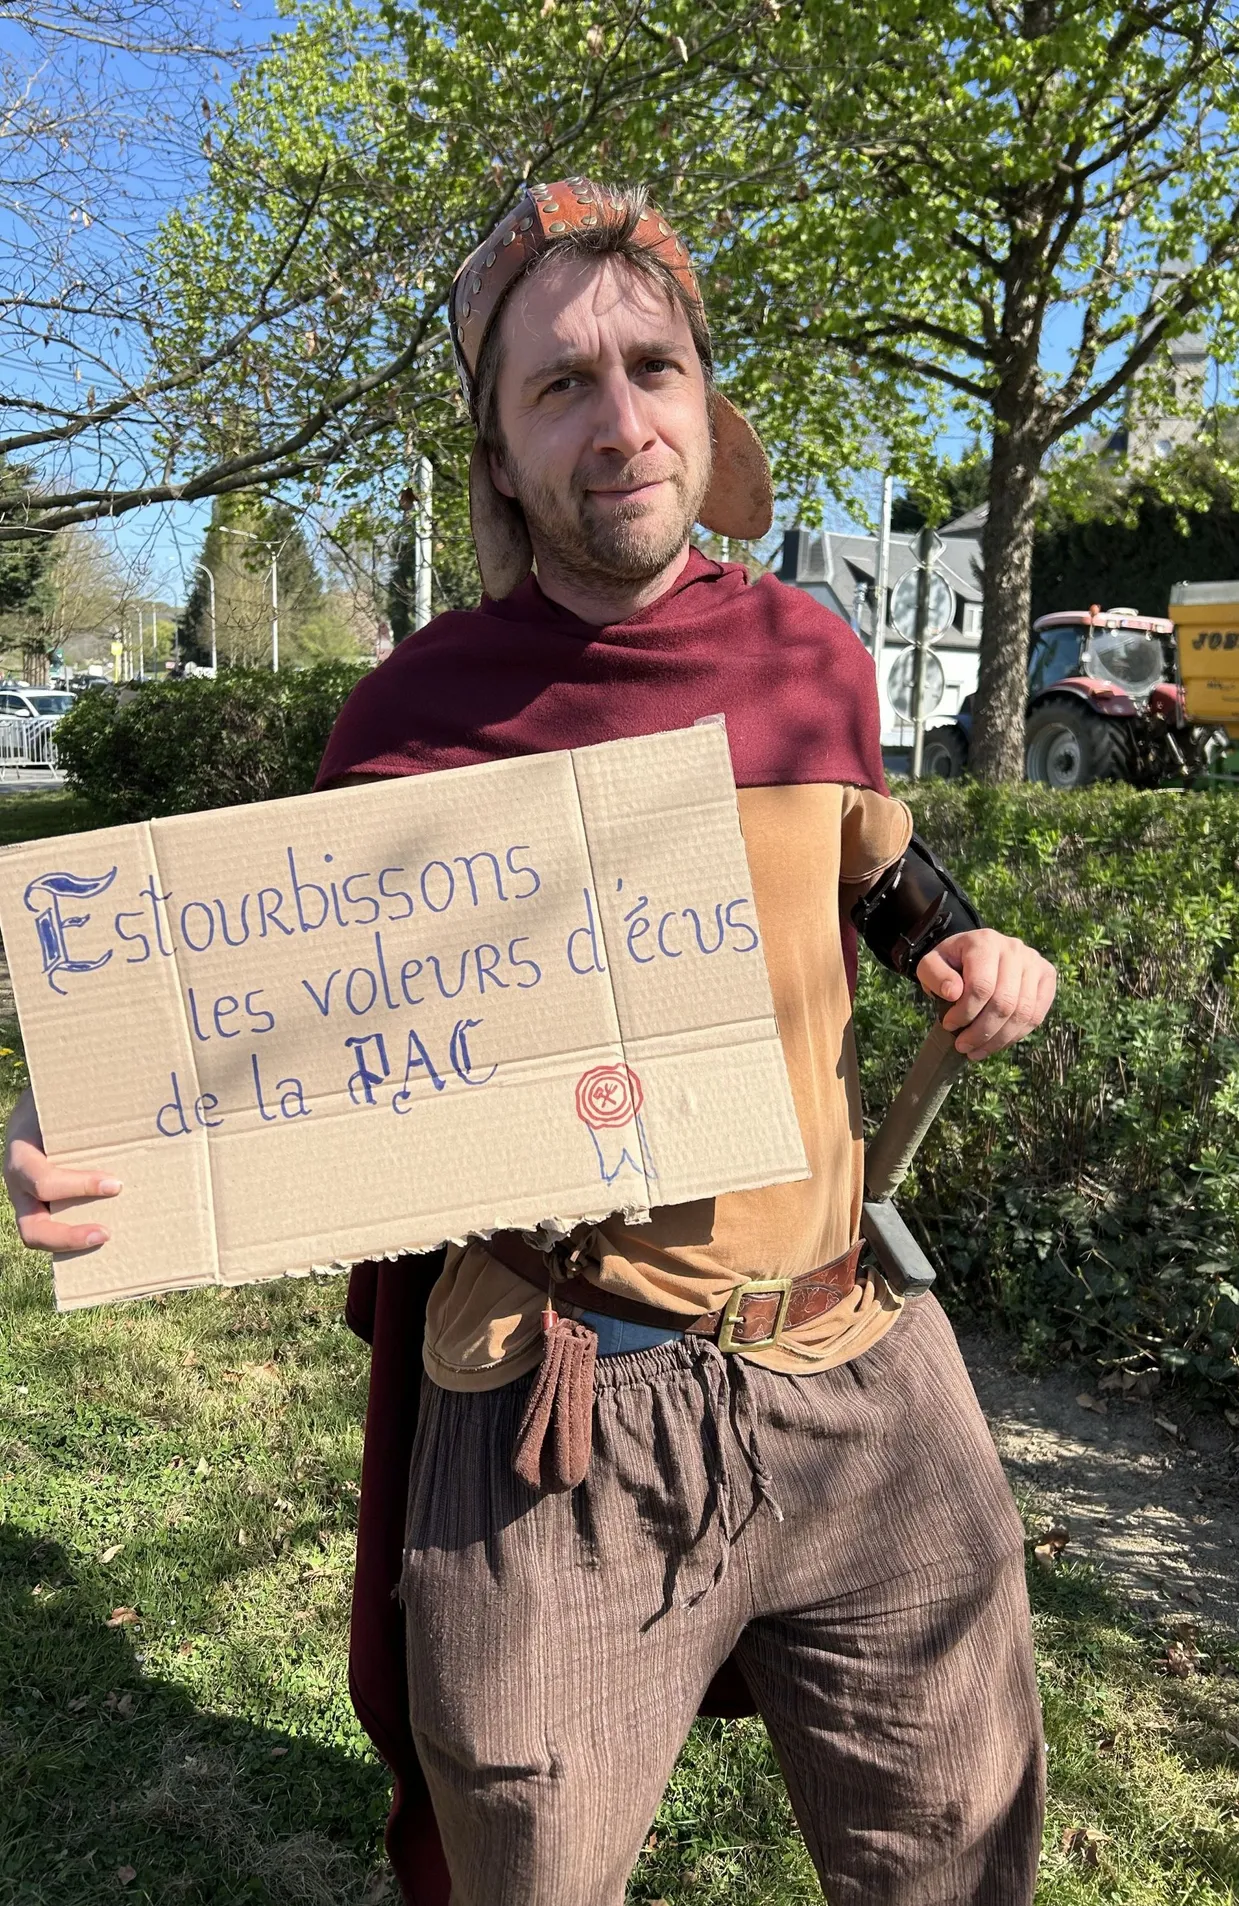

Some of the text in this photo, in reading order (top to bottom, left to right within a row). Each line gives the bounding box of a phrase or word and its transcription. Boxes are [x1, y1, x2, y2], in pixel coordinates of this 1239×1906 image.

[188, 987, 276, 1042] les
[566, 877, 760, 976] d'écus
[156, 1018, 499, 1137] de la PAC
